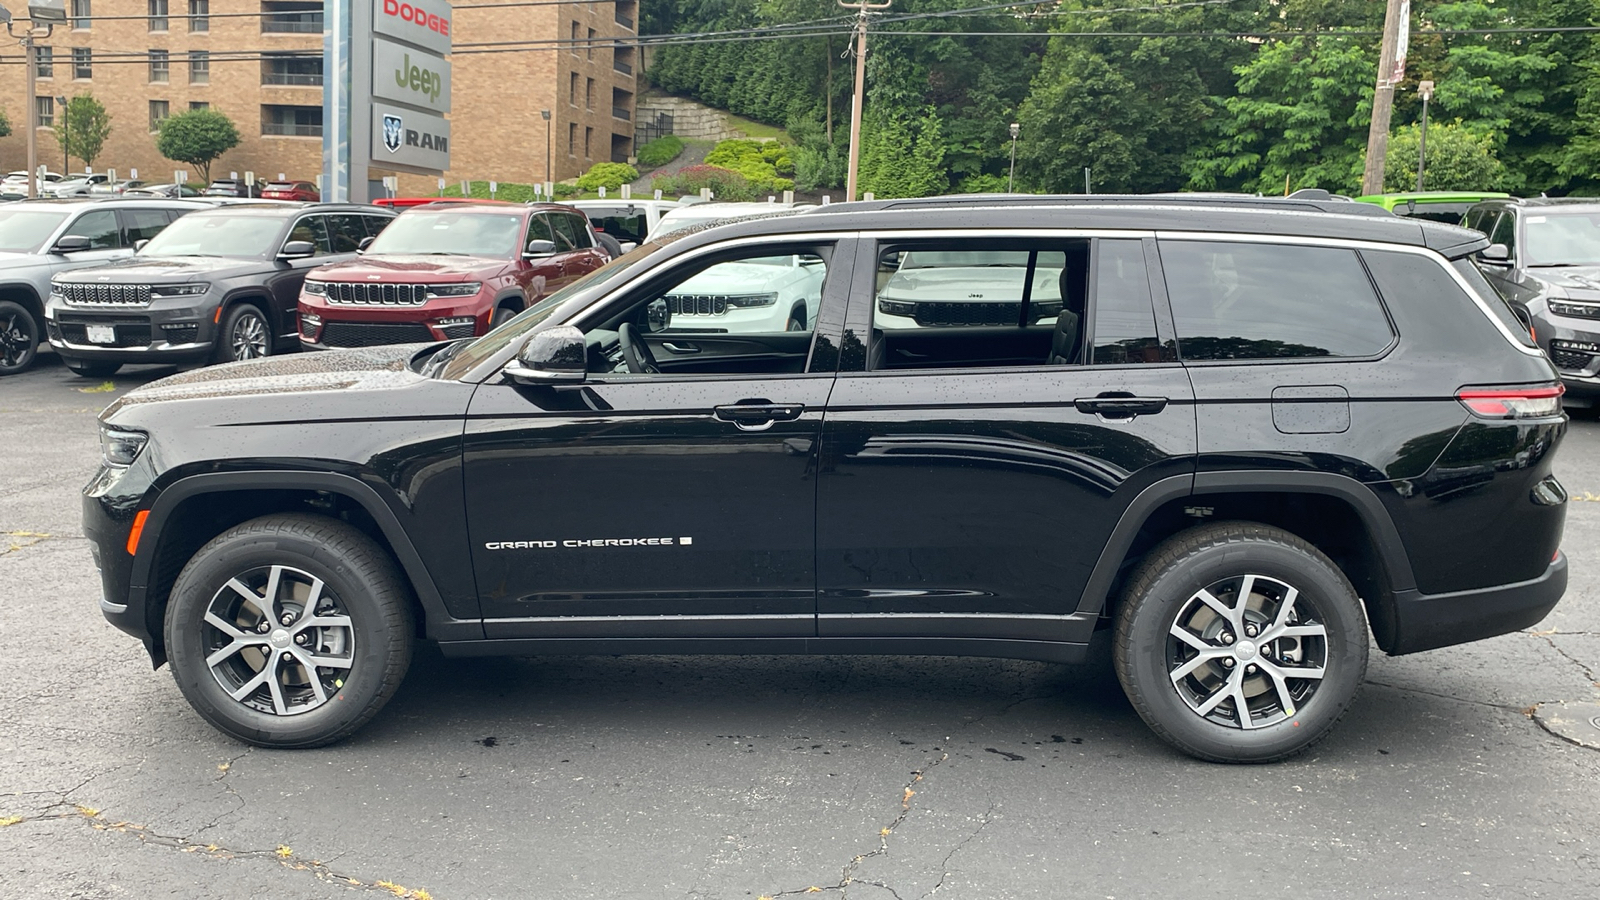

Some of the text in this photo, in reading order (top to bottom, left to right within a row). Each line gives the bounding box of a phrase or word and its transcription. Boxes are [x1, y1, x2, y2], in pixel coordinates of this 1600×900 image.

[383, 0, 449, 37] DODGE
[395, 53, 441, 103] Jeep
[405, 128, 448, 153] RAM
[485, 540, 557, 550] GRAND
[562, 537, 674, 548] CHEROKEE
